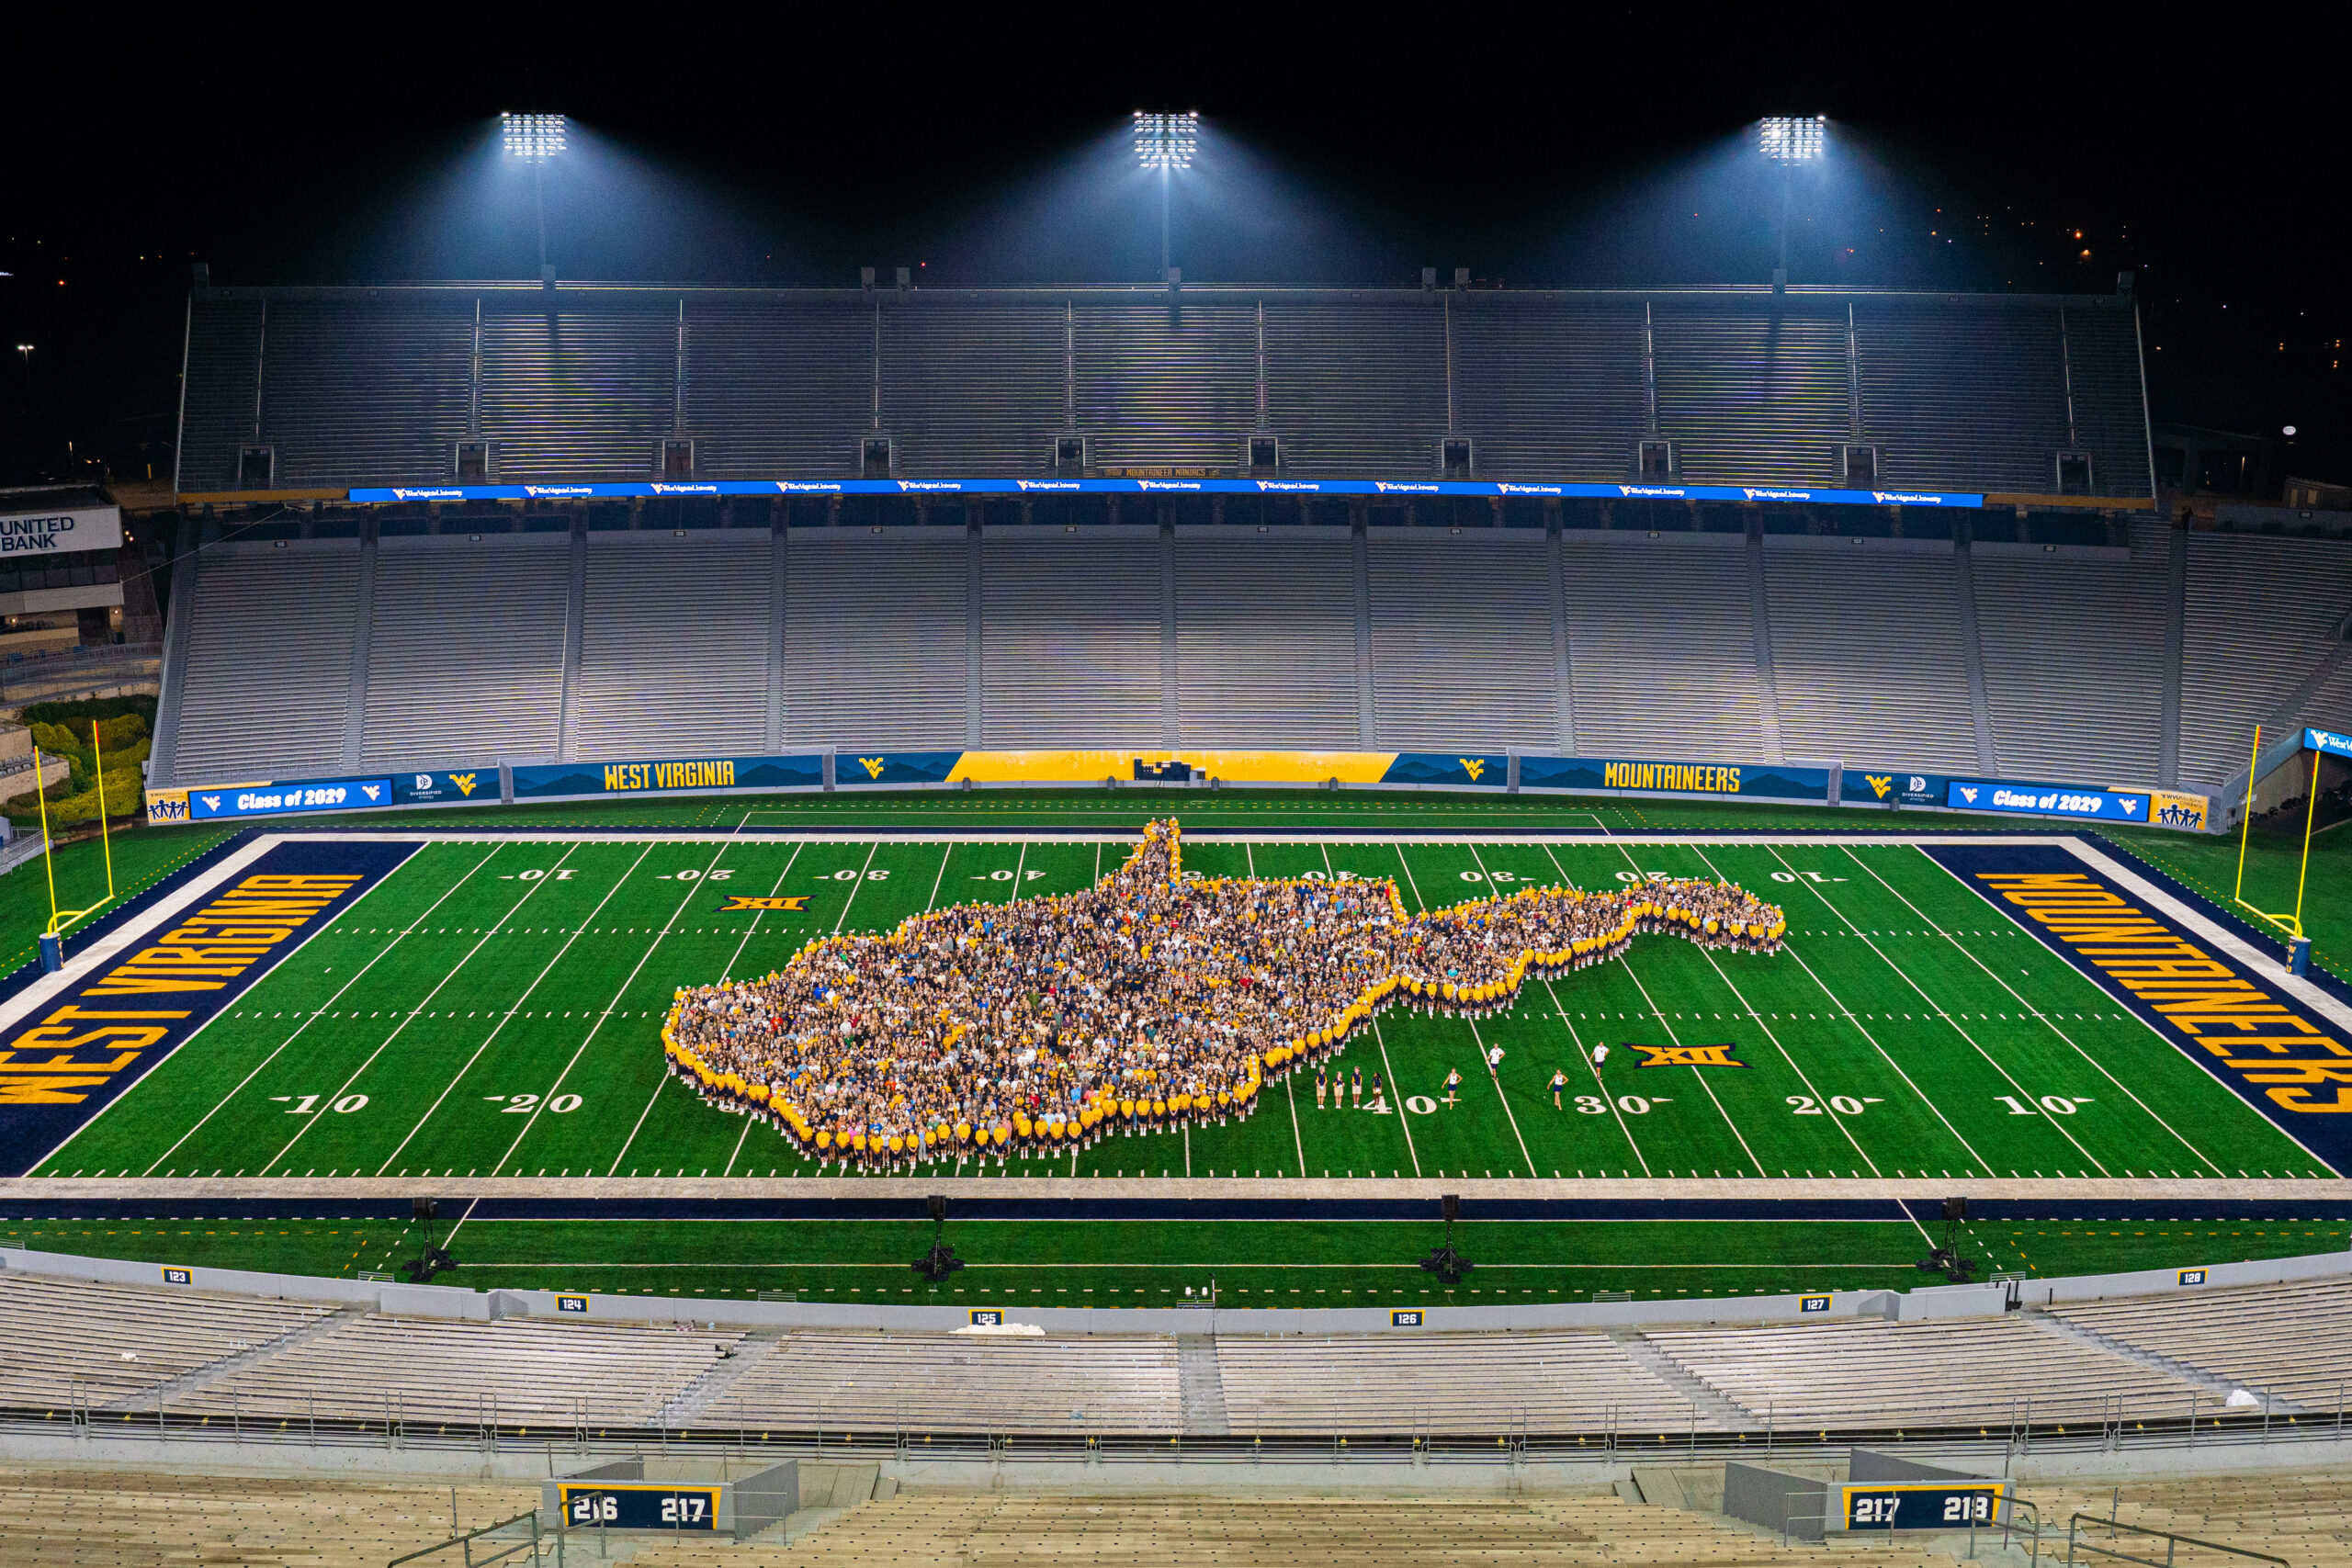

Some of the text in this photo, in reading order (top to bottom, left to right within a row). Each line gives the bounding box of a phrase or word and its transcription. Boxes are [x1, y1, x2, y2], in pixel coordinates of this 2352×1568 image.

[1126, 468, 1172, 477] MOUNTAINEER
[1175, 468, 1205, 477] MANIACS
[937, 482, 961, 491] University
[1056, 482, 1080, 491] University
[1176, 482, 1200, 491] University
[1415, 484, 1439, 492] University
[1520, 485, 1537, 493] Virginia
[1537, 486, 1561, 494] University
[1659, 488, 1685, 496] University
[417, 490, 435, 498] Virginia
[435, 490, 462, 498] University
[1784, 491, 1810, 500] University
[1915, 494, 1941, 503] University
[0, 517, 74, 536] UNITED
[1, 533, 57, 551] BANK
[2328, 737, 2346, 750] West
[605, 761, 734, 790] WEST VIRGINIA
[1604, 762, 1740, 792] MOUNTAINEERS
[237, 787, 345, 810] Class of 2029
[1993, 790, 2102, 813] Class of 2029
[518, 869, 579, 880] 10
[676, 869, 735, 880] 20
[834, 869, 890, 880] 30
[990, 870, 1046, 880] 40
[1459, 871, 1515, 882] 30
[1770, 872, 1830, 882] 10
[0, 874, 364, 1104] WEST VIRGINIA
[1974, 874, 2352, 1112] MOUNTAINEERS
[285, 1095, 369, 1113] 10
[501, 1095, 583, 1113] 20
[1363, 1095, 1437, 1114] 40
[1574, 1095, 1650, 1114] 30
[1785, 1095, 1864, 1115] 20
[1994, 1095, 2076, 1115] 10
[169, 1271, 186, 1282] 123
[2185, 1273, 2201, 1283] 128
[563, 1299, 582, 1310] 124
[1807, 1299, 1825, 1310] 127
[978, 1314, 996, 1324] 125
[1398, 1314, 1417, 1325] 126
[573, 1495, 706, 1522] 216 217
[1856, 1496, 1988, 1522] 217 218
